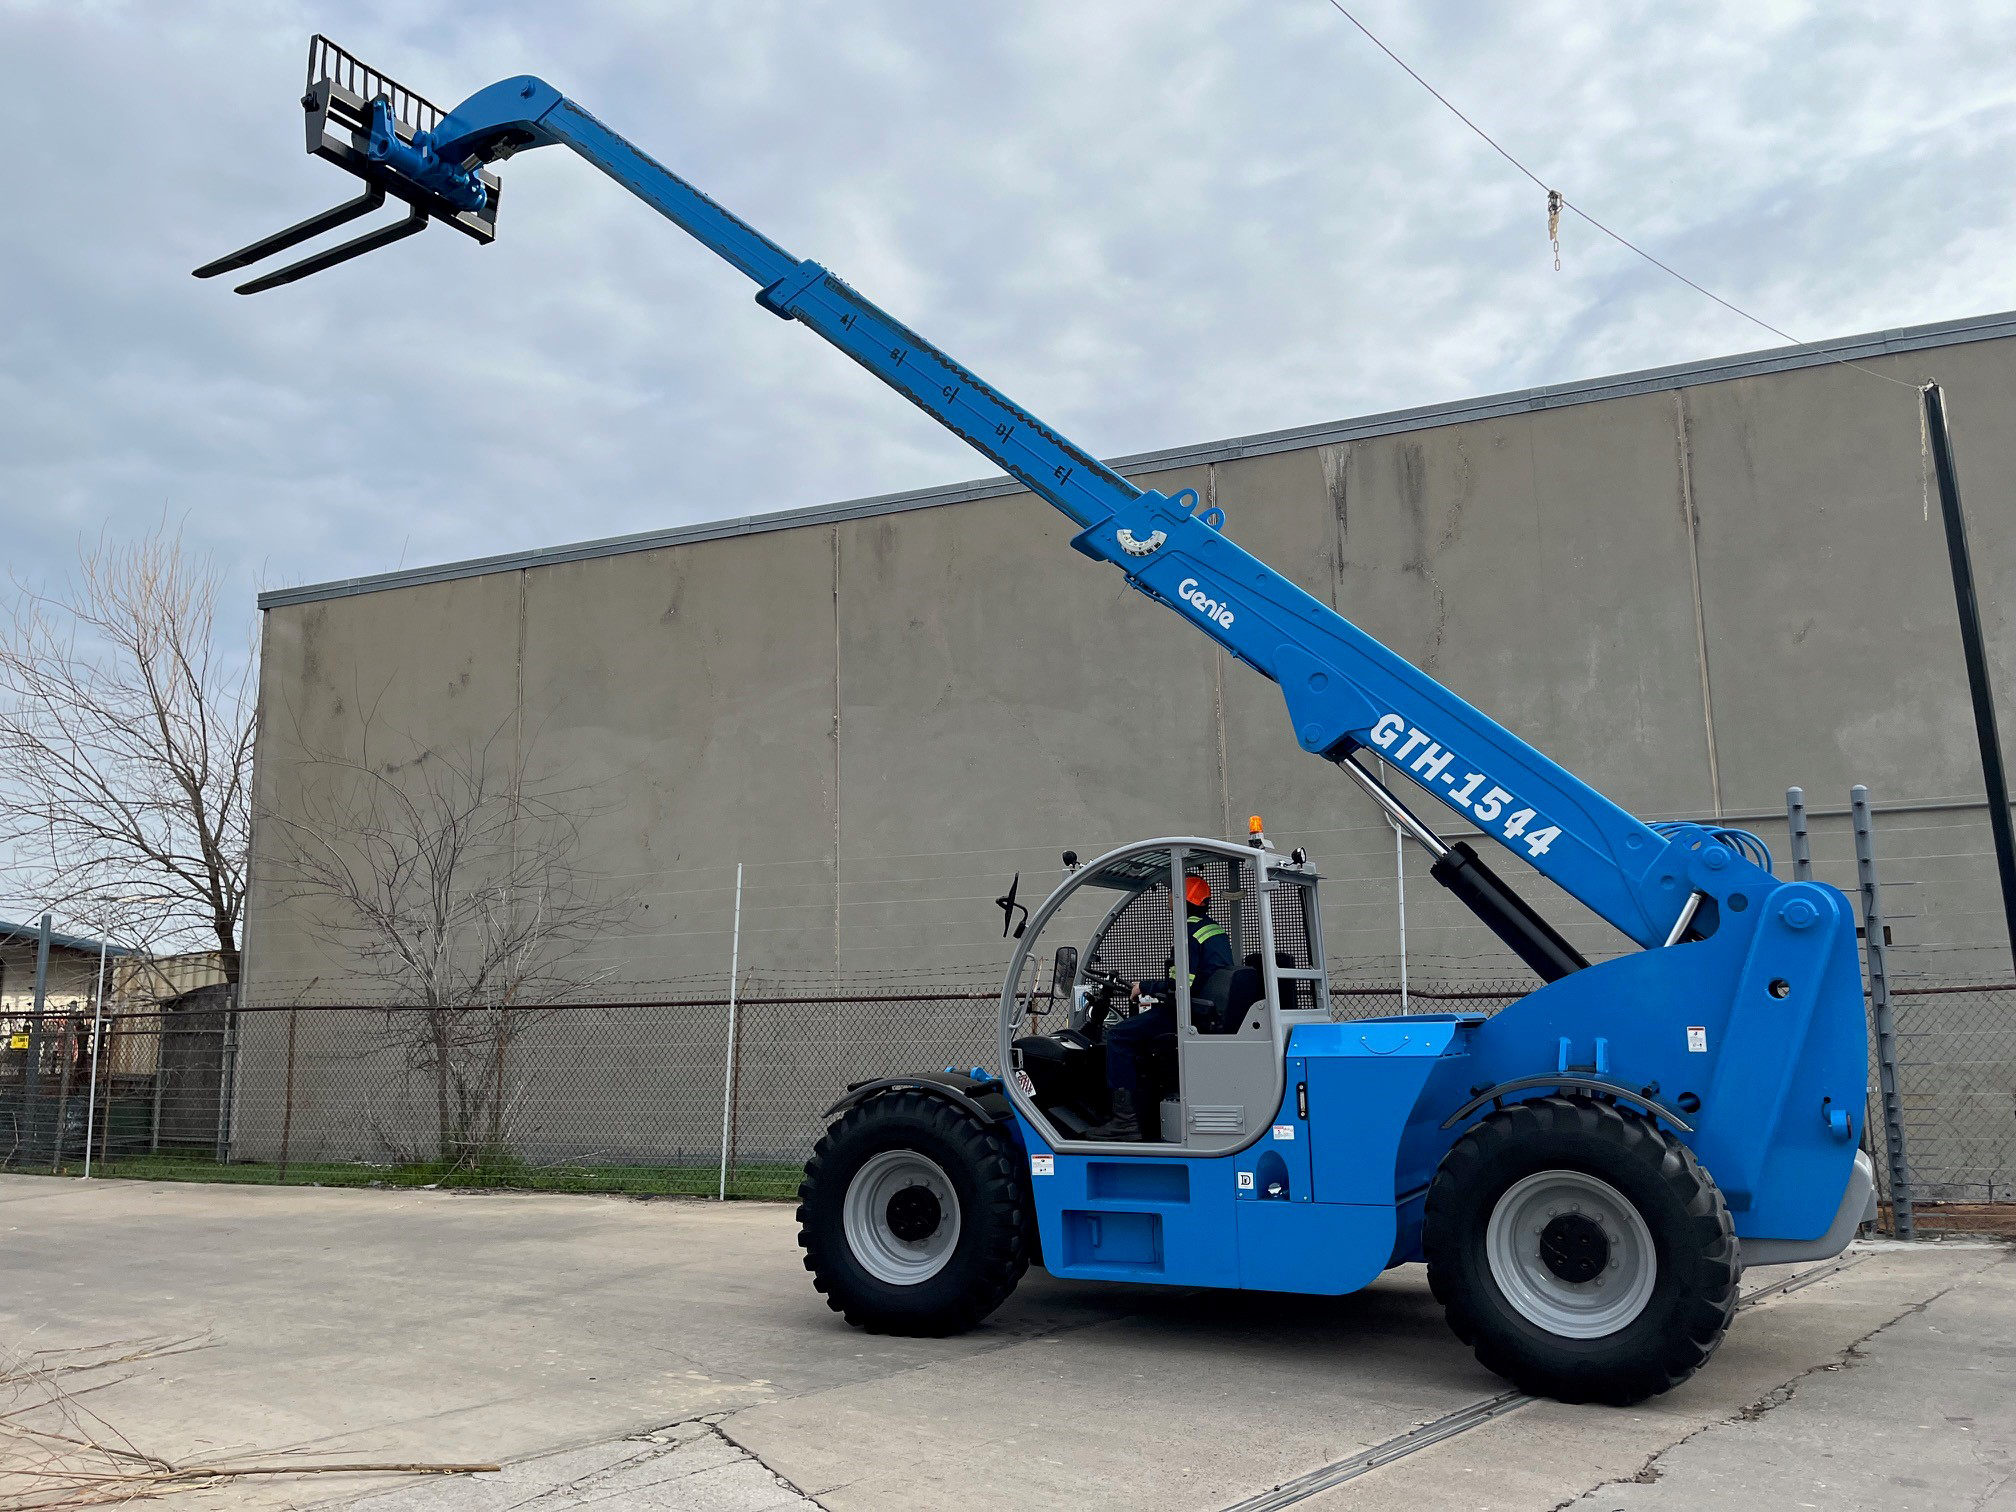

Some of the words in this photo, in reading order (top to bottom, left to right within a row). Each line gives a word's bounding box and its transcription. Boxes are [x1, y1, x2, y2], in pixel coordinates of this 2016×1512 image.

[840, 314, 849, 324] A
[889, 348, 900, 360] B
[995, 423, 1006, 435] D
[1054, 466, 1065, 478] E
[1178, 578, 1234, 629] Genie
[1370, 713, 1562, 857] GTH-1544
